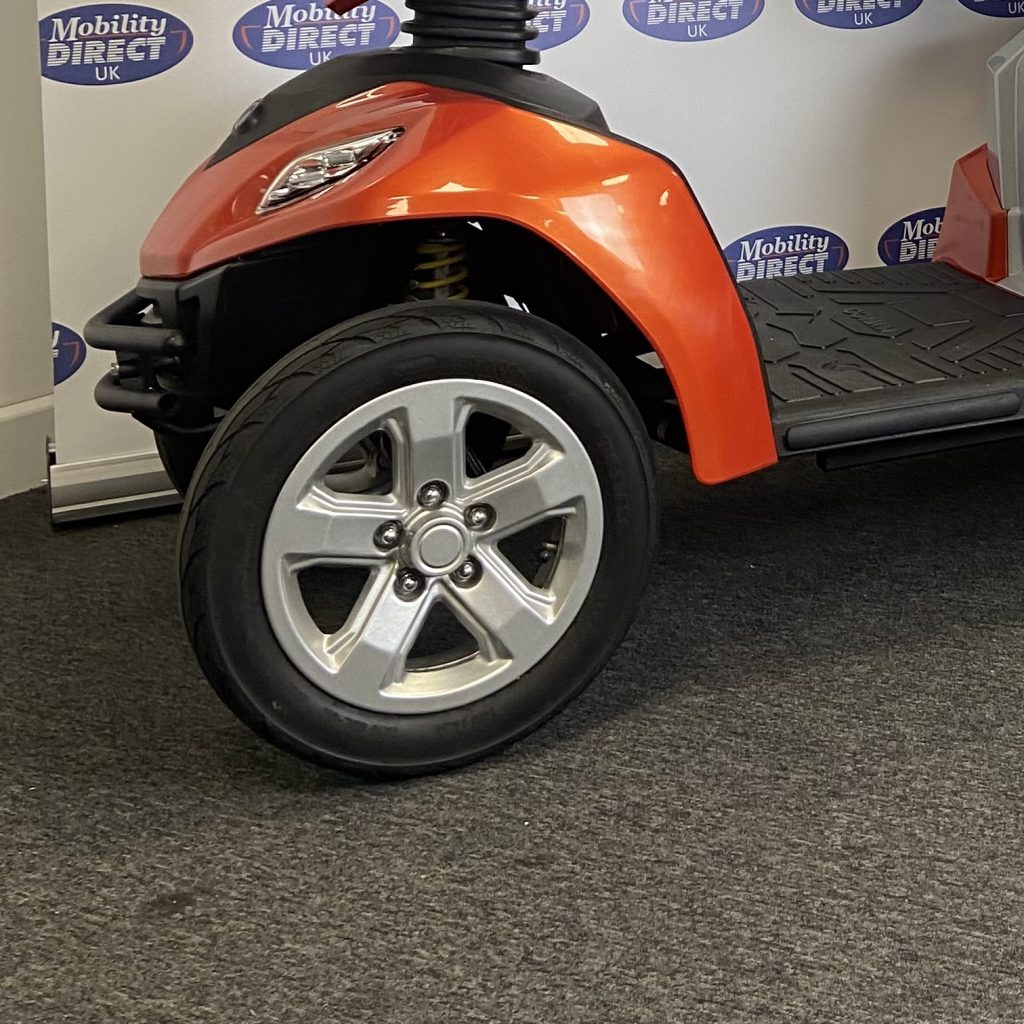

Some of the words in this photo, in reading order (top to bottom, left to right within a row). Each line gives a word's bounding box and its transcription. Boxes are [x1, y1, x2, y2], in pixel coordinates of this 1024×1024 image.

[49, 13, 167, 43] Mobility
[687, 23, 708, 38] UK
[854, 11, 873, 26] UK
[46, 36, 166, 67] DIRECT
[261, 22, 376, 52] DIRECT
[95, 65, 121, 81] UK
[309, 50, 332, 66] UK
[739, 233, 830, 263] Mobility
[735, 252, 829, 284] DIRECT
